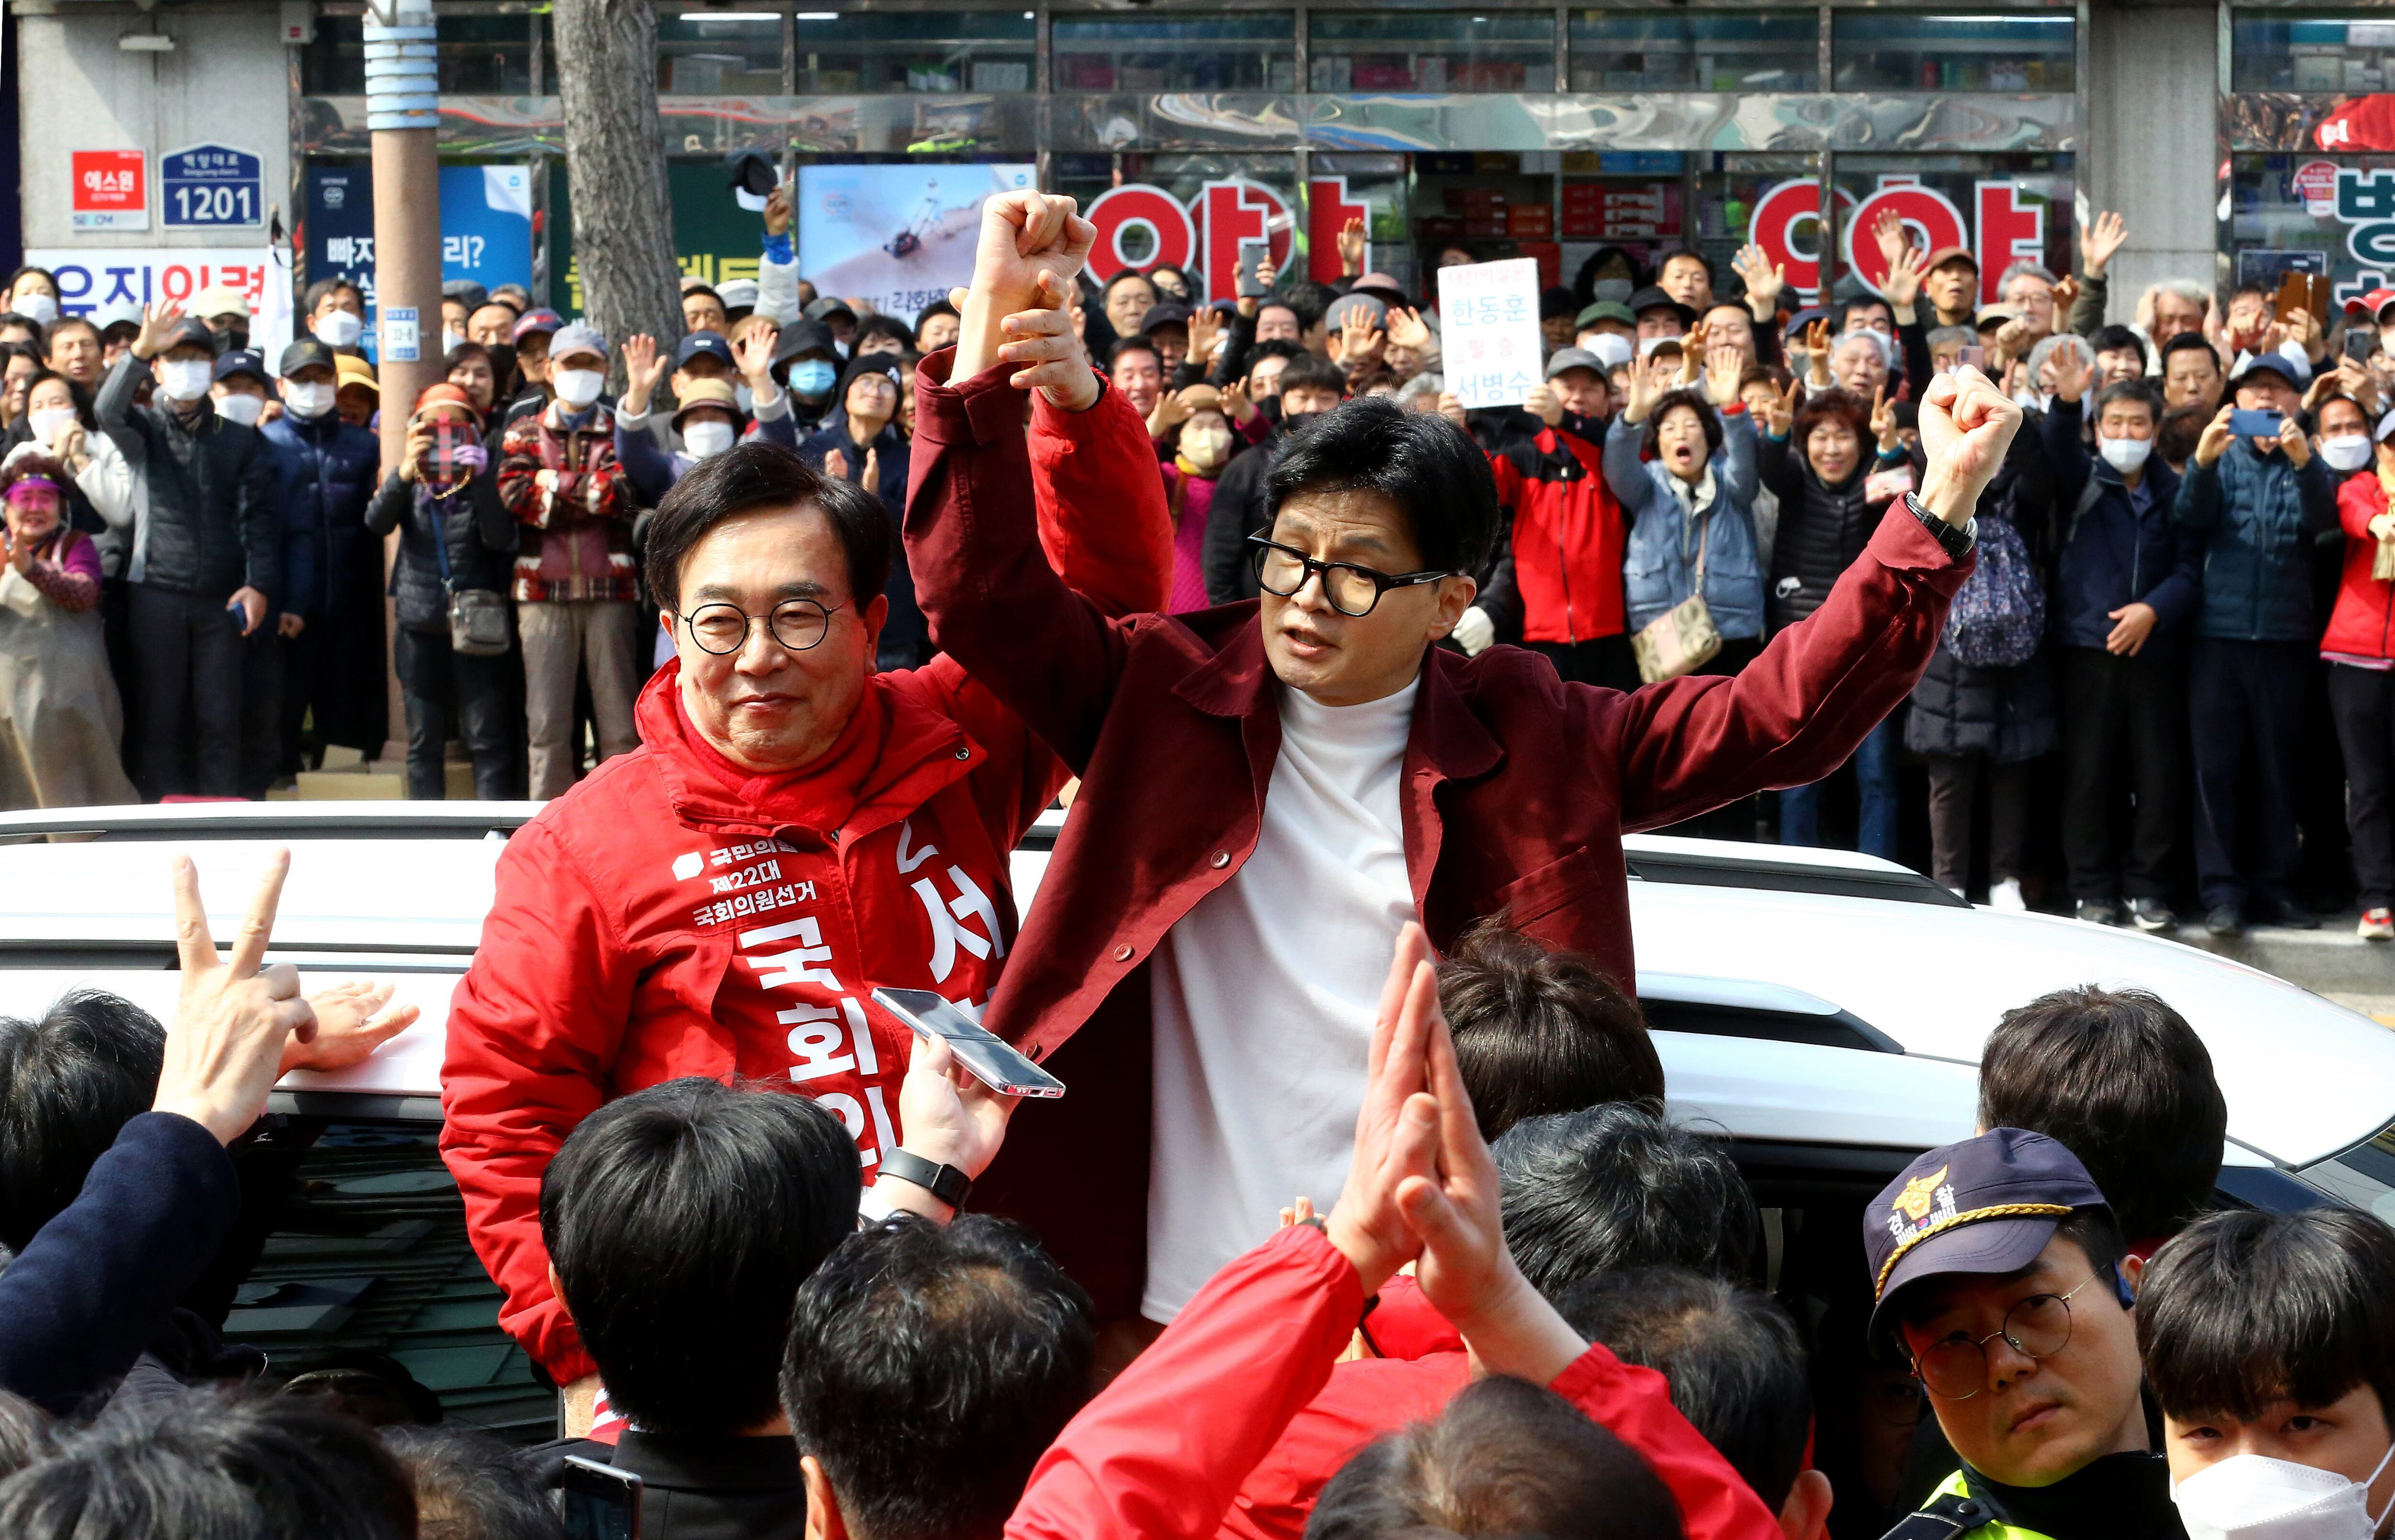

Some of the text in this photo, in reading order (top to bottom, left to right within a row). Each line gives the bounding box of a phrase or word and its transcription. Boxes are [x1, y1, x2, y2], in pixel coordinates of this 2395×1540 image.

[175, 186, 251, 220] 1201
[1451, 294, 1528, 326] 한동훈
[1457, 370, 1532, 401] 서병수
[708, 859, 782, 895] 제22대
[692, 880, 818, 927] 국회의원선거
[738, 915, 897, 1170] 국회의
